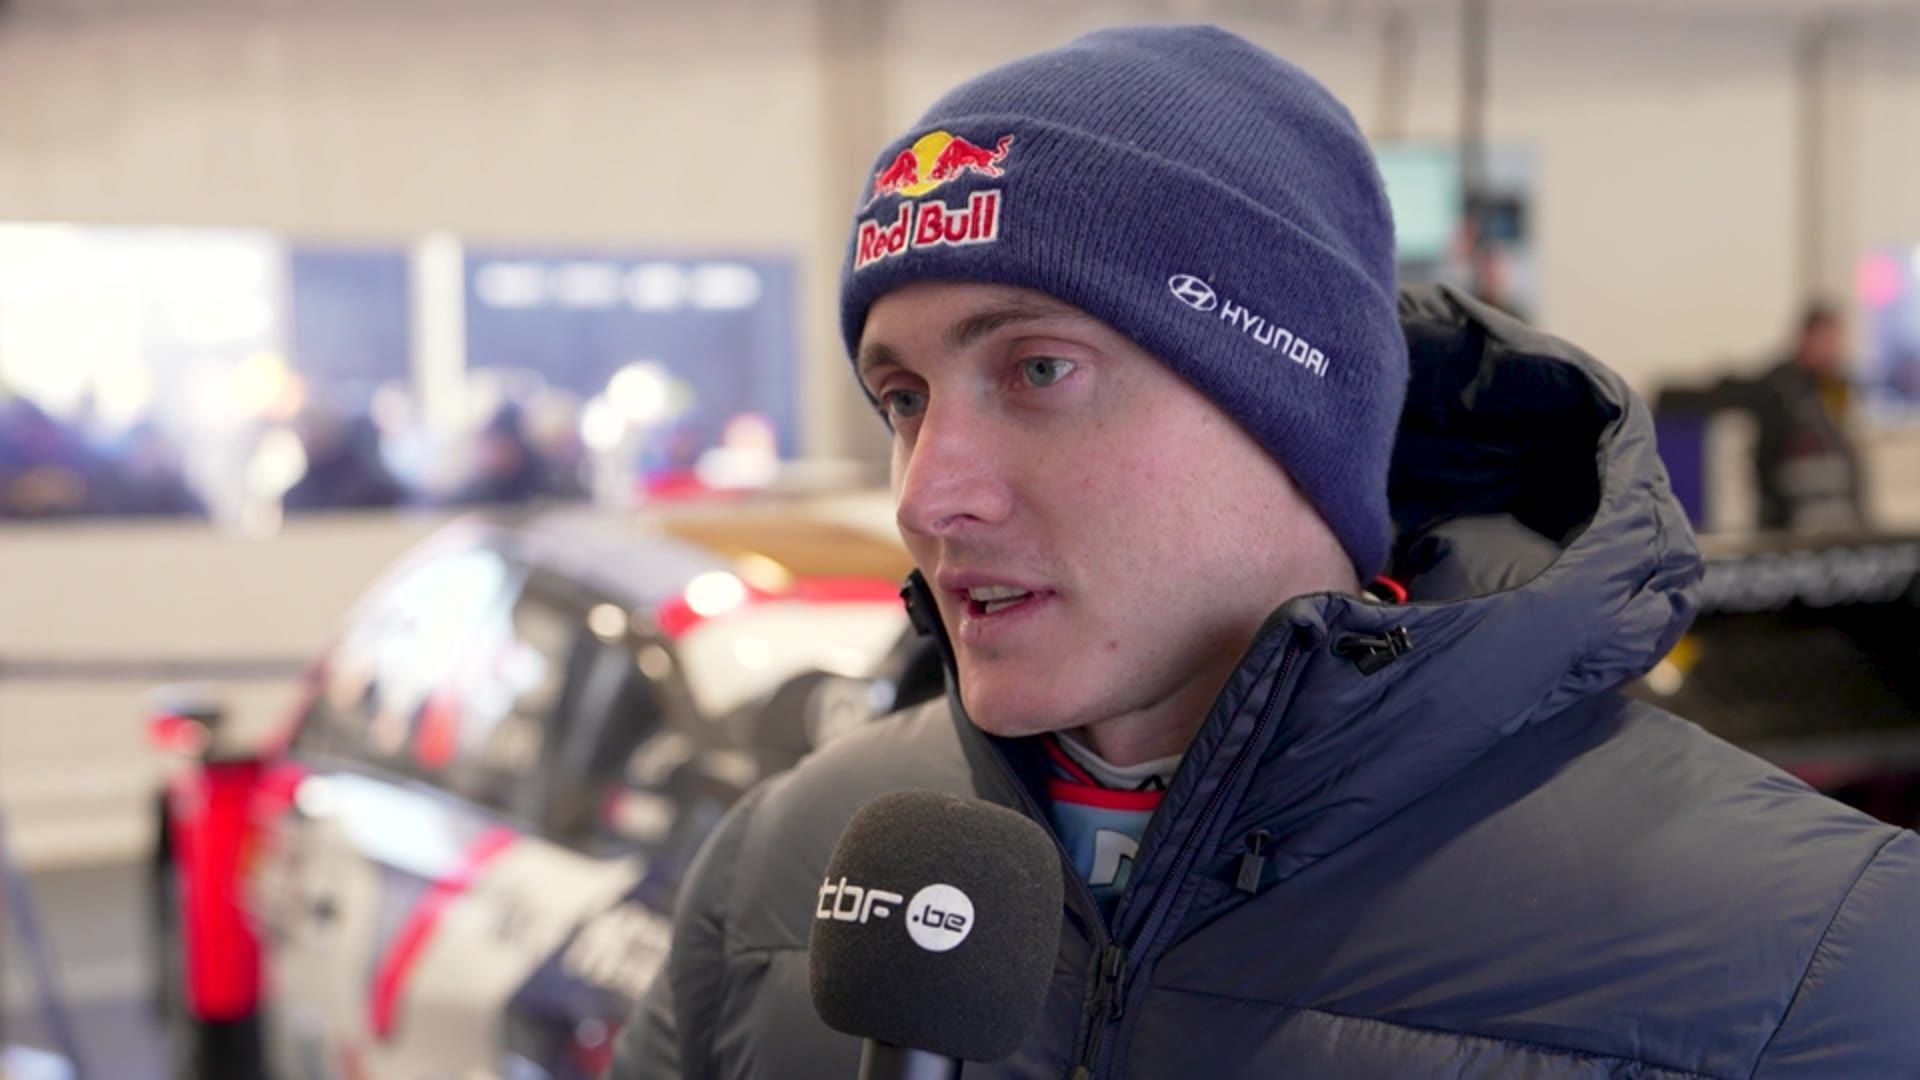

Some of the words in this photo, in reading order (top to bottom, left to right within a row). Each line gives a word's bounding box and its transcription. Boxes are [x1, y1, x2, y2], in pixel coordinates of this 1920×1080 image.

[856, 203, 912, 270] Red
[912, 191, 1000, 247] Bull
[1220, 299, 1330, 377] HYUNDAI
